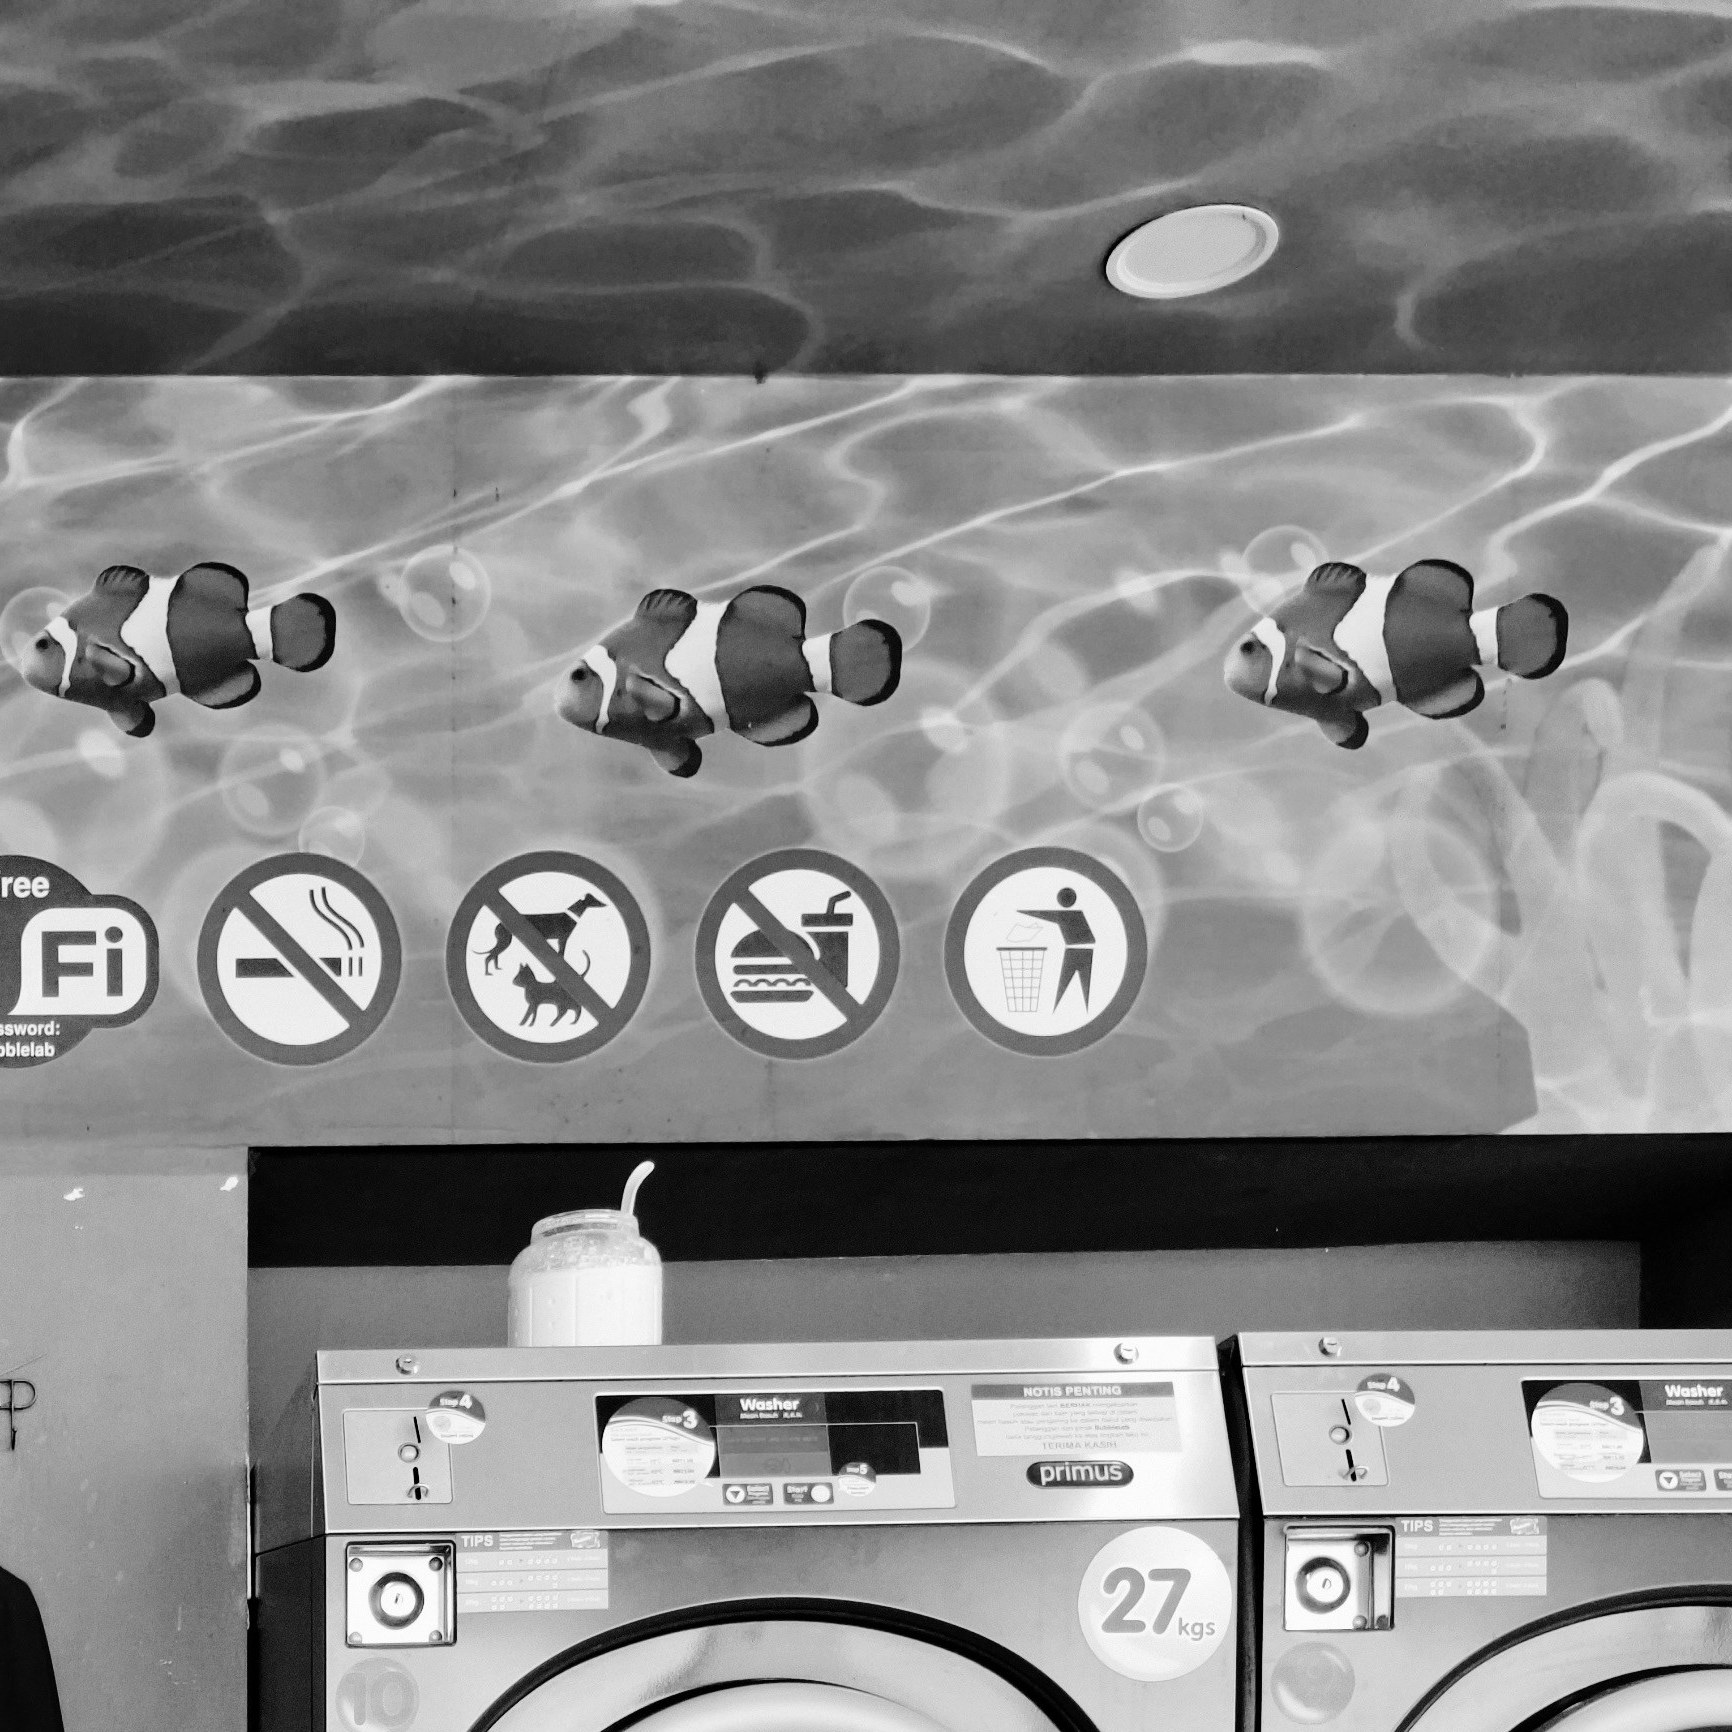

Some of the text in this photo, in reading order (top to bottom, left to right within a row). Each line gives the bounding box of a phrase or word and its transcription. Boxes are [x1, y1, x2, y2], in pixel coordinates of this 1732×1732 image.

[1387, 1376, 1400, 1392] 4
[1665, 1384, 1724, 1397] Washer
[1024, 1386, 1122, 1397] NOTIS PENTING
[459, 1394, 472, 1409] 4
[740, 1398, 799, 1411] Washer
[1609, 1396, 1624, 1416] 3
[683, 1409, 698, 1429] 3
[859, 1464, 868, 1475] 5
[1040, 1461, 1123, 1485] primus
[1401, 1520, 1434, 1532] TIPS
[461, 1535, 493, 1547] TIPS
[1101, 1567, 1216, 1641] 27 kgs
